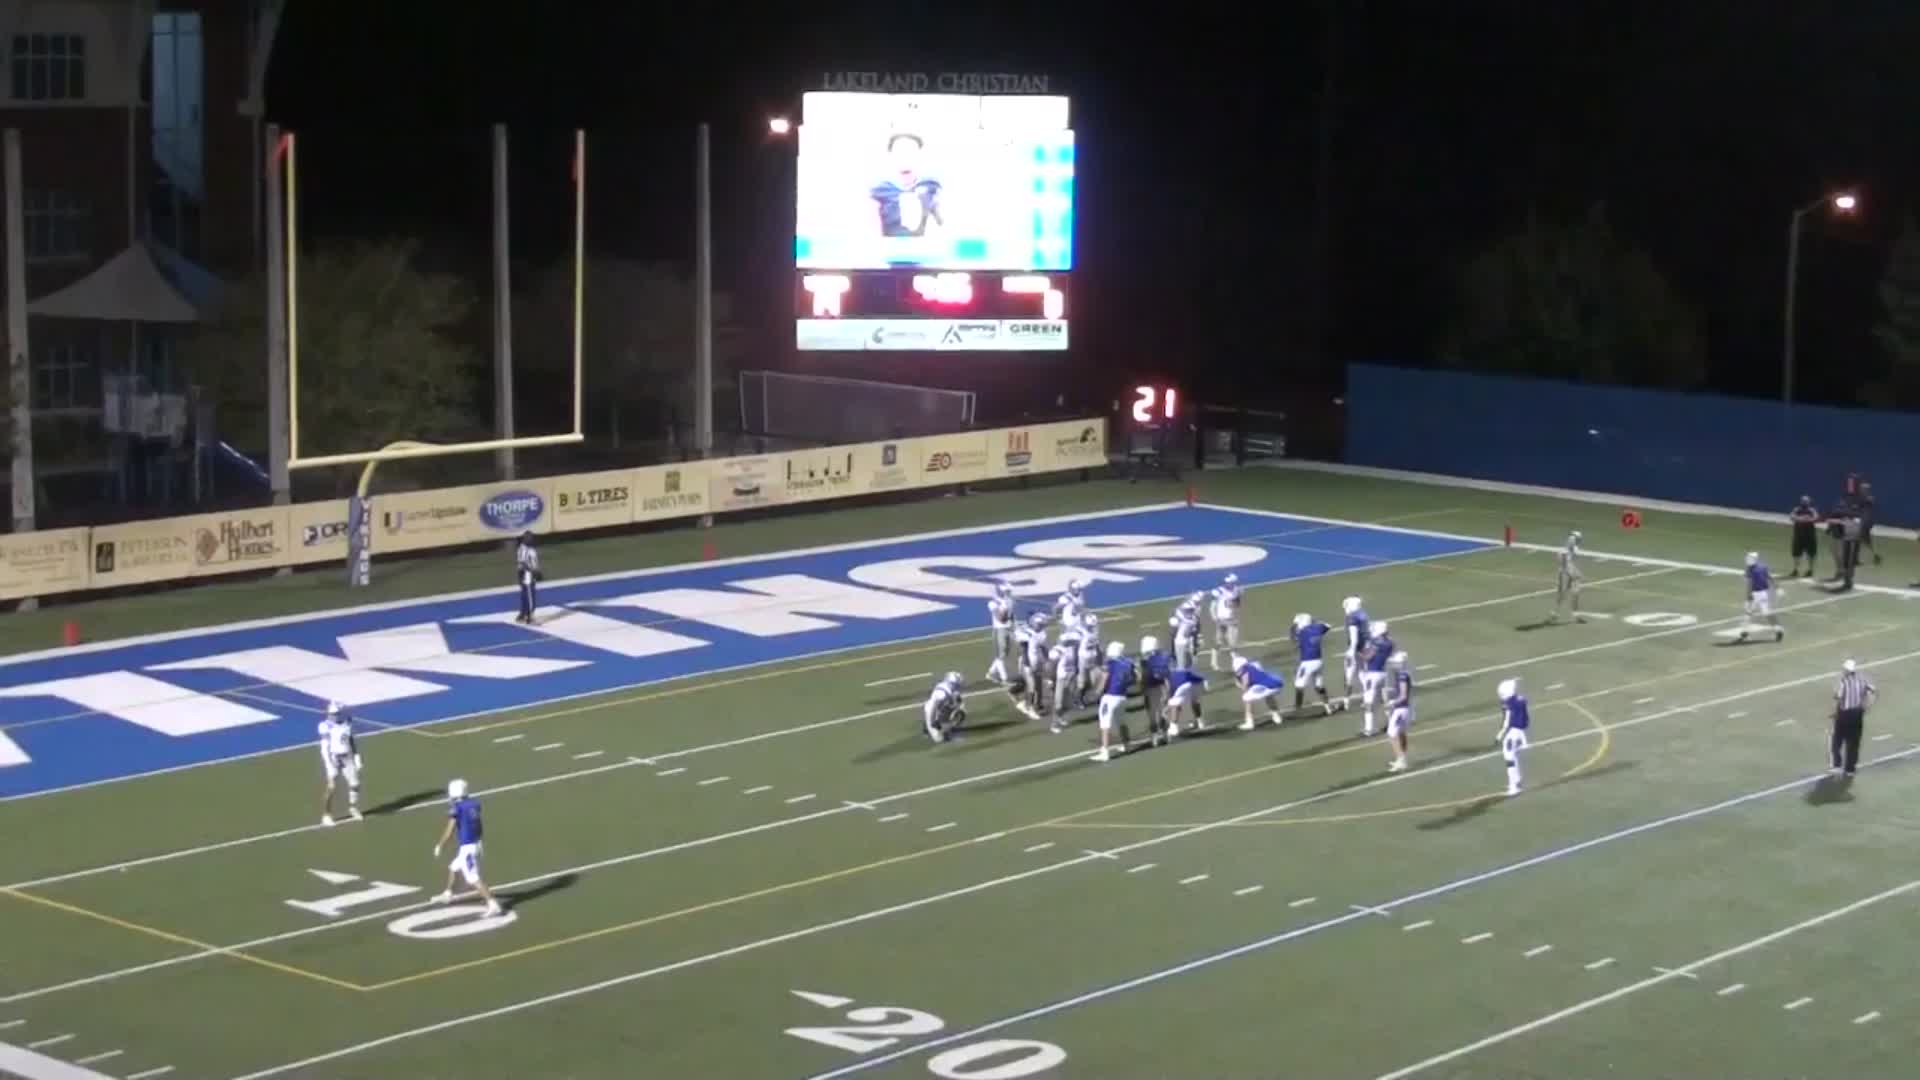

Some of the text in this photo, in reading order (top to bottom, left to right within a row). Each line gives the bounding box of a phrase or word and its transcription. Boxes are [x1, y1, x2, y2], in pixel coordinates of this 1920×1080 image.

[823, 71, 1049, 93] LAKELAND CHRISTIAN
[1009, 324, 1063, 335] GREEN
[1132, 385, 1177, 422] 21
[587, 486, 630, 505] TIRES
[486, 496, 539, 518] THORPE
[220, 519, 274, 544] Hulbert
[227, 540, 274, 562] Homes
[0, 534, 1268, 767] IKINGS
[783, 1007, 1067, 1080] 20
